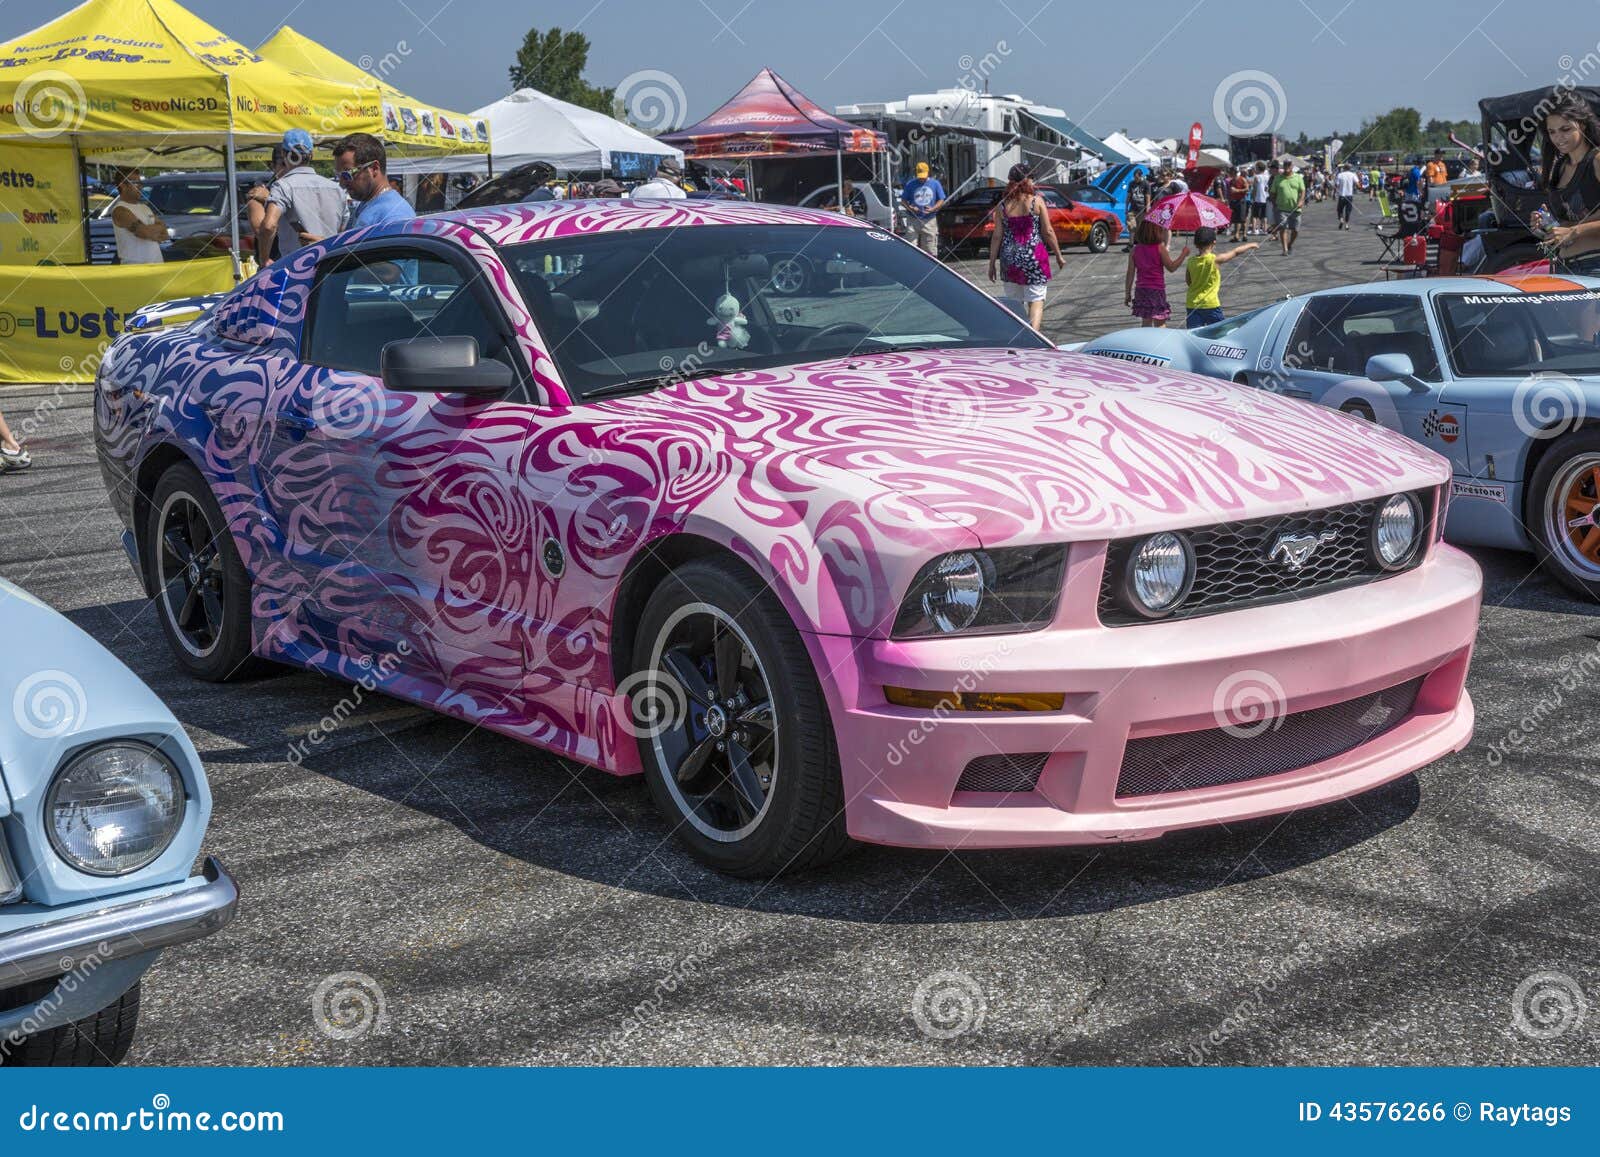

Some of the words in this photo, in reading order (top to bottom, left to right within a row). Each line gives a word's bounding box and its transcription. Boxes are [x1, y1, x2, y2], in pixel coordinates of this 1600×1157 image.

[94, 34, 164, 49] Produits
[132, 96, 218, 112] SavoNic3D
[1208, 345, 1246, 359] GIRLING
[1439, 424, 1459, 434] Gulf
[1455, 484, 1502, 497] Firestone
